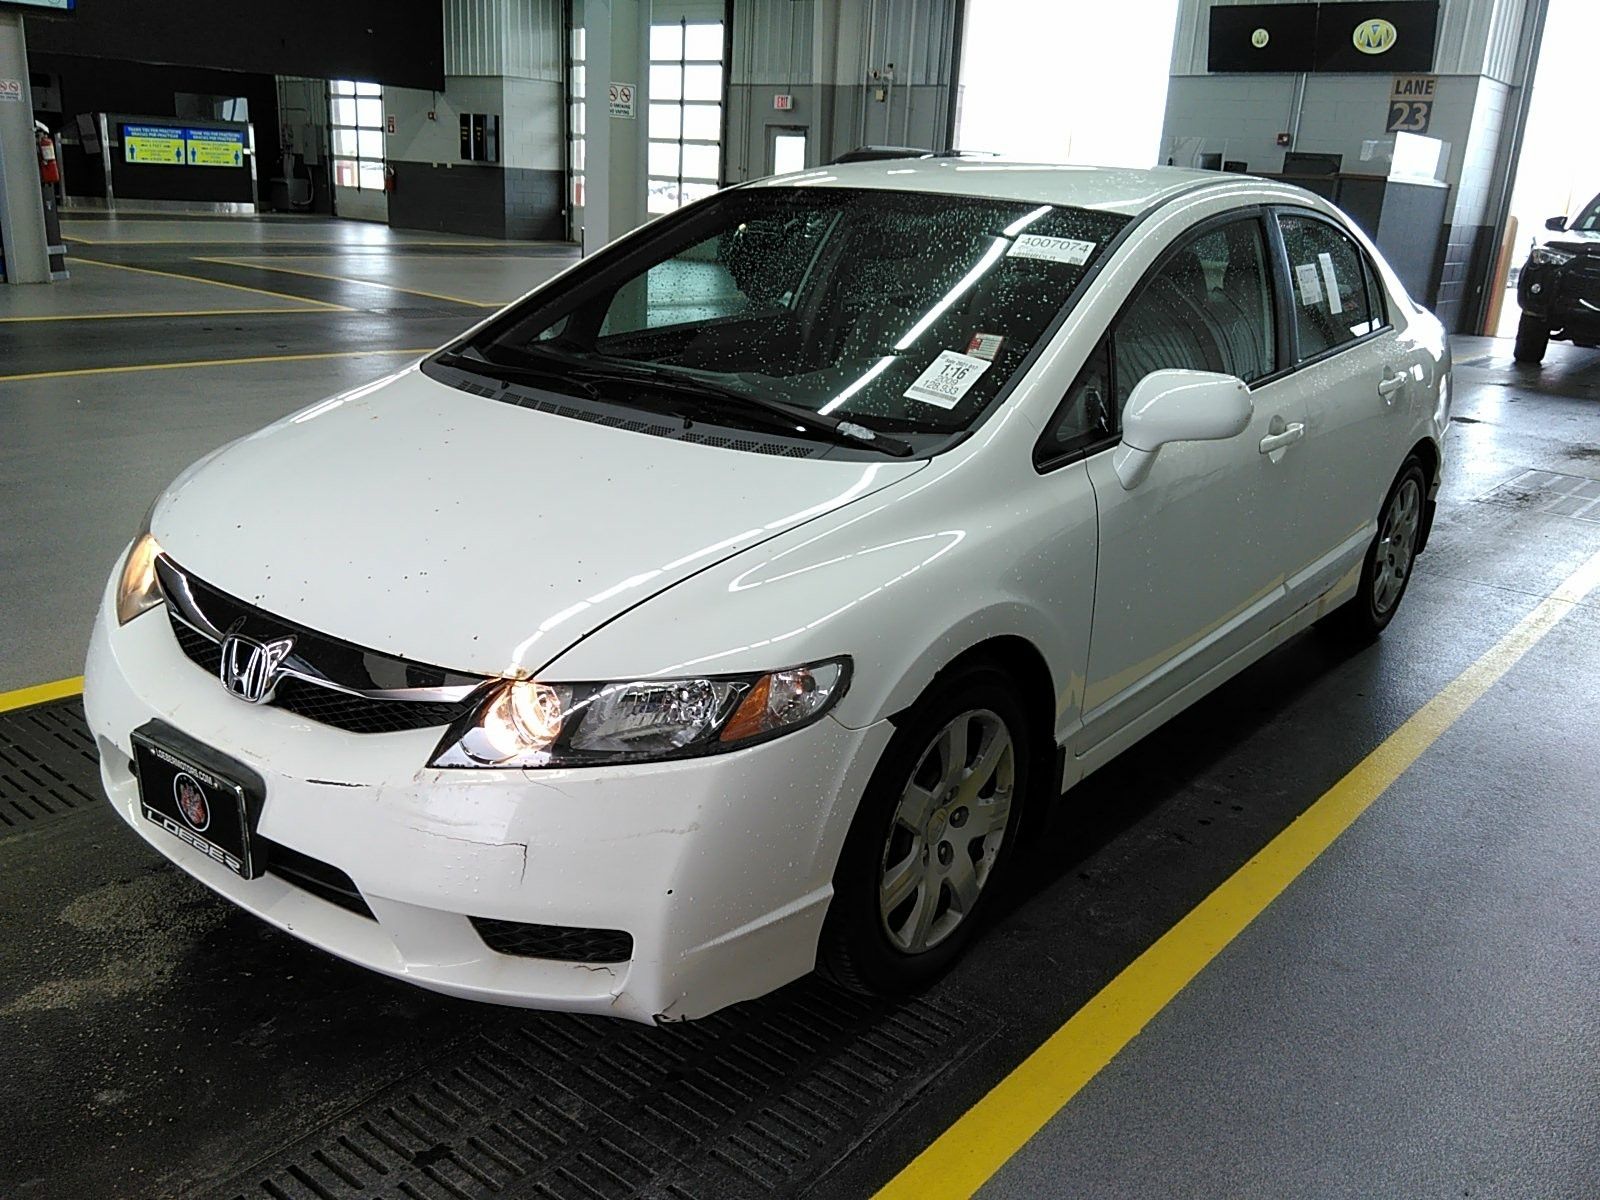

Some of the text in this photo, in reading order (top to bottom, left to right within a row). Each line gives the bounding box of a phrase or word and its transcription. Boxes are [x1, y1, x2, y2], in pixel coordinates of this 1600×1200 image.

[1394, 79, 1435, 95] LANE
[776, 96, 789, 108] EXIT
[1389, 102, 1428, 131] 23
[1021, 237, 1089, 253] 4007074
[941, 364, 969, 380] 1:16
[935, 375, 959, 386] 2009
[147, 810, 240, 874] LOEBER
